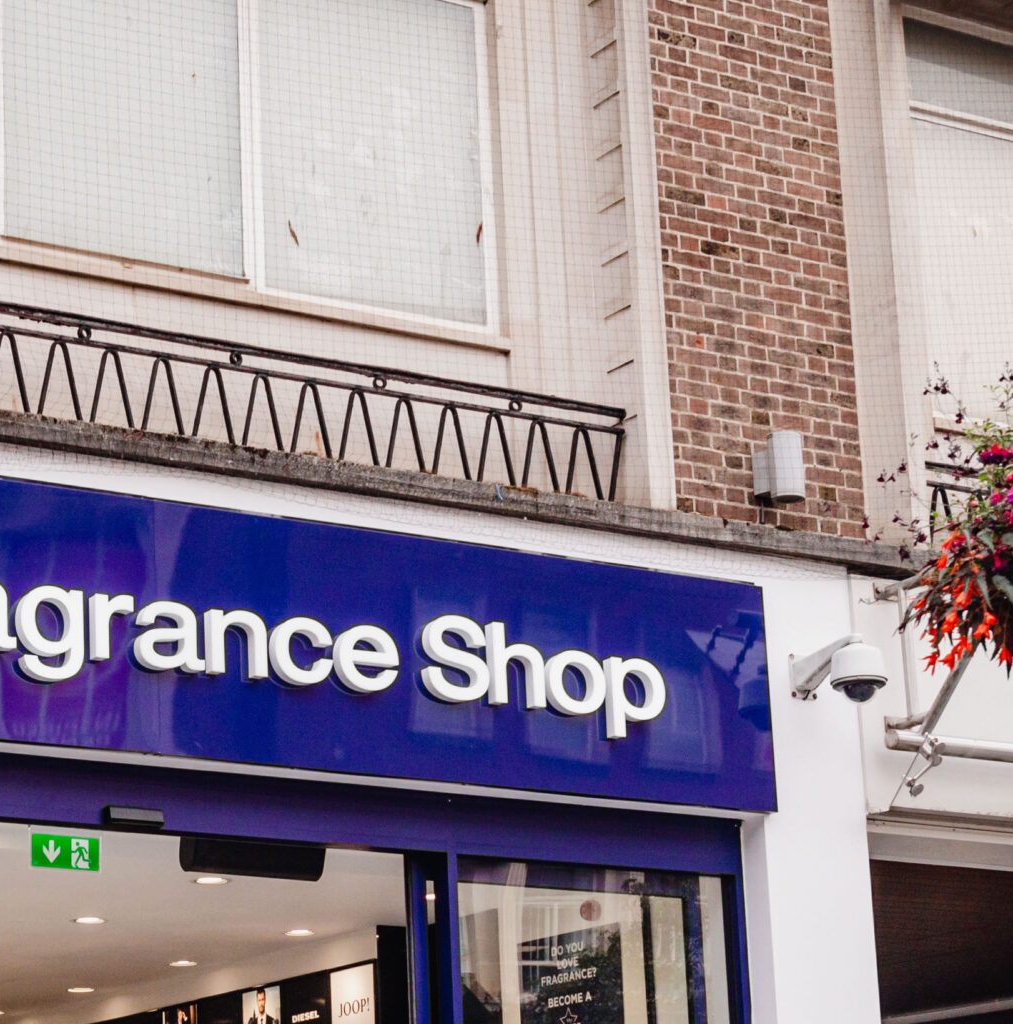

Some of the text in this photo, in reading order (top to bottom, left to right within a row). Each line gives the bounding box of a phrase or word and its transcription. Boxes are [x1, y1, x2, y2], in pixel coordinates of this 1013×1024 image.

[421, 615, 667, 739] Shop
[551, 941, 584, 957] DO YOU
[557, 958, 579, 970] LOVE
[541, 967, 597, 987] FRAGRANCE?
[338, 997, 370, 1018] JOOP!
[548, 991, 592, 1008] BECOME A
[292, 1010, 320, 1024] DIESEL
